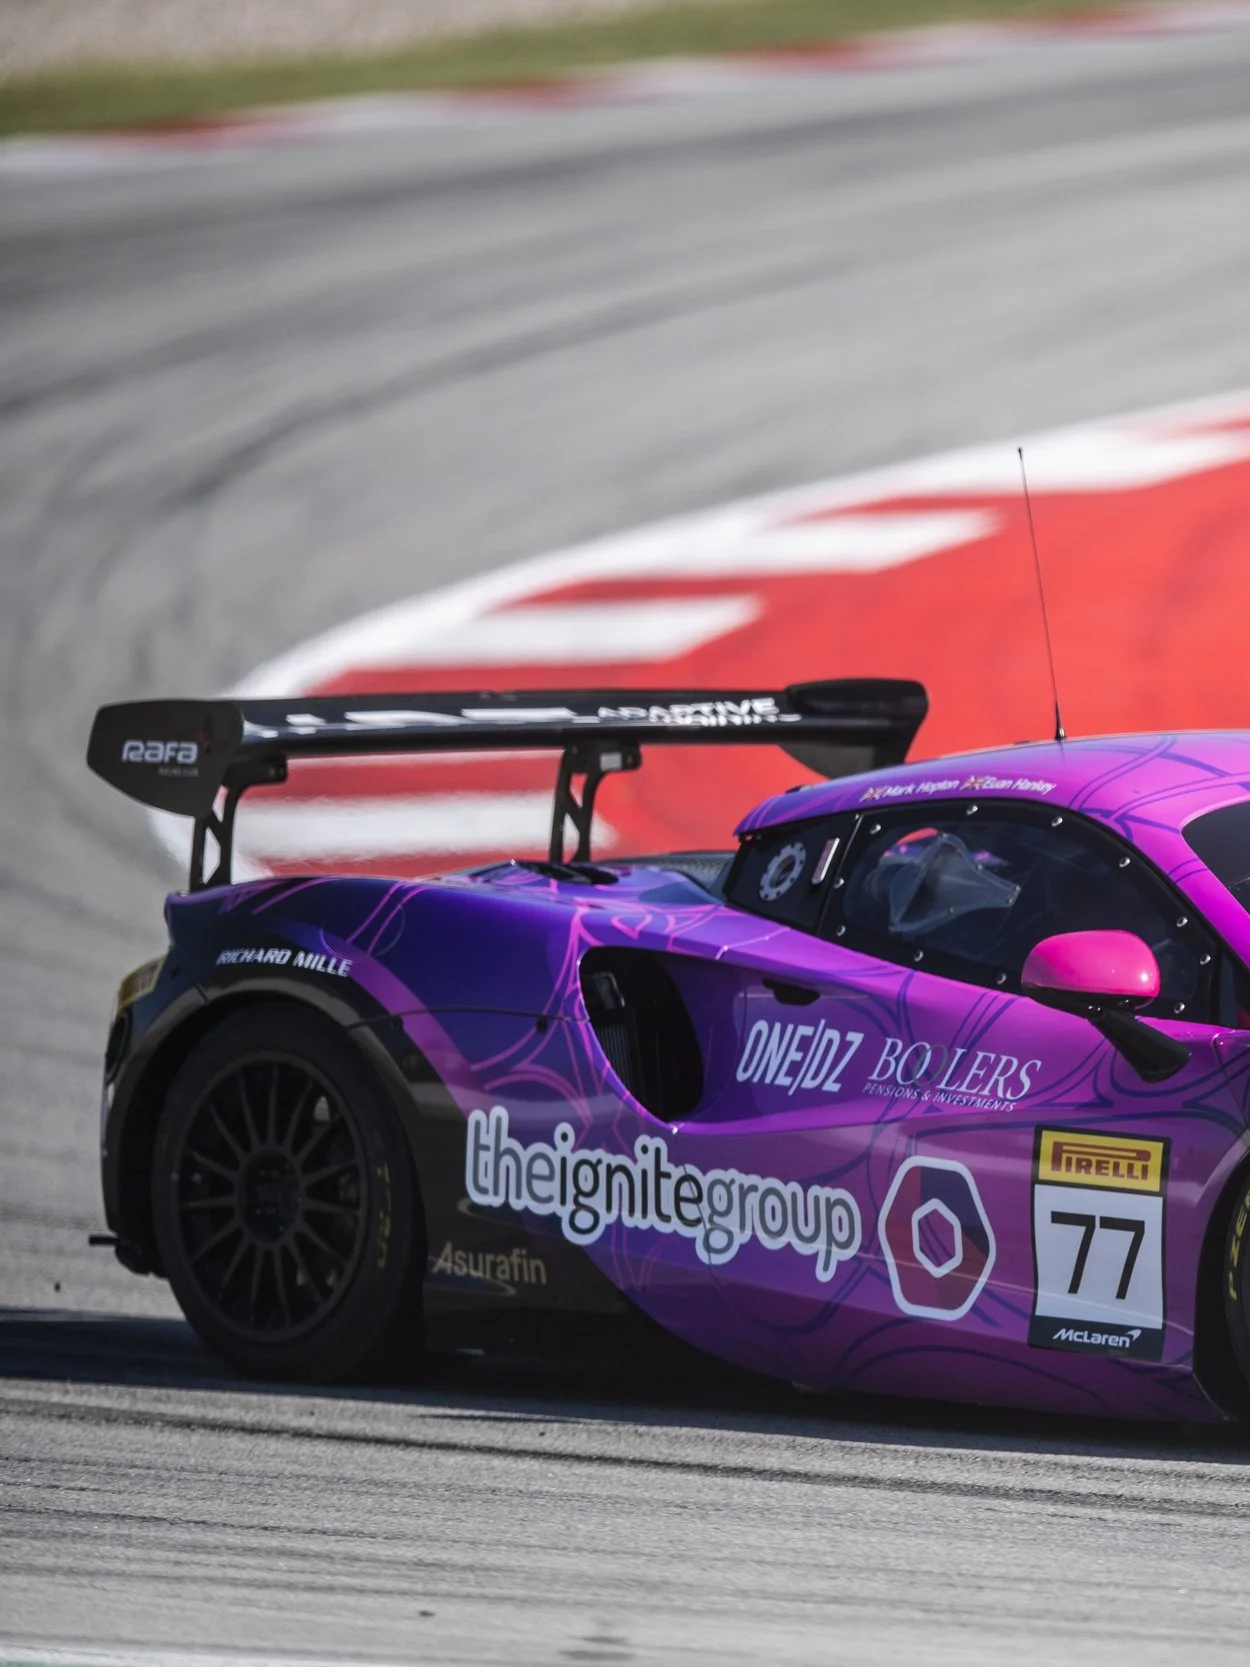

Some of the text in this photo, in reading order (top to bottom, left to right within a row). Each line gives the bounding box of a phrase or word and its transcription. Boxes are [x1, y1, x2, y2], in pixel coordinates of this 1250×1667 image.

[883, 785, 914, 798] Mark
[216, 947, 354, 977] RICHARD MILLE
[736, 1019, 864, 1096] ONE/DZ
[862, 1082, 1017, 1113] PENSIONS & INVESTMENTS
[1051, 1140, 1151, 1181] PIRELLI
[467, 1106, 861, 1281] theignitegroup
[433, 1241, 547, 1285] Asurafin
[1051, 1210, 1145, 1300] 77
[1053, 1328, 1142, 1348] McLaren
